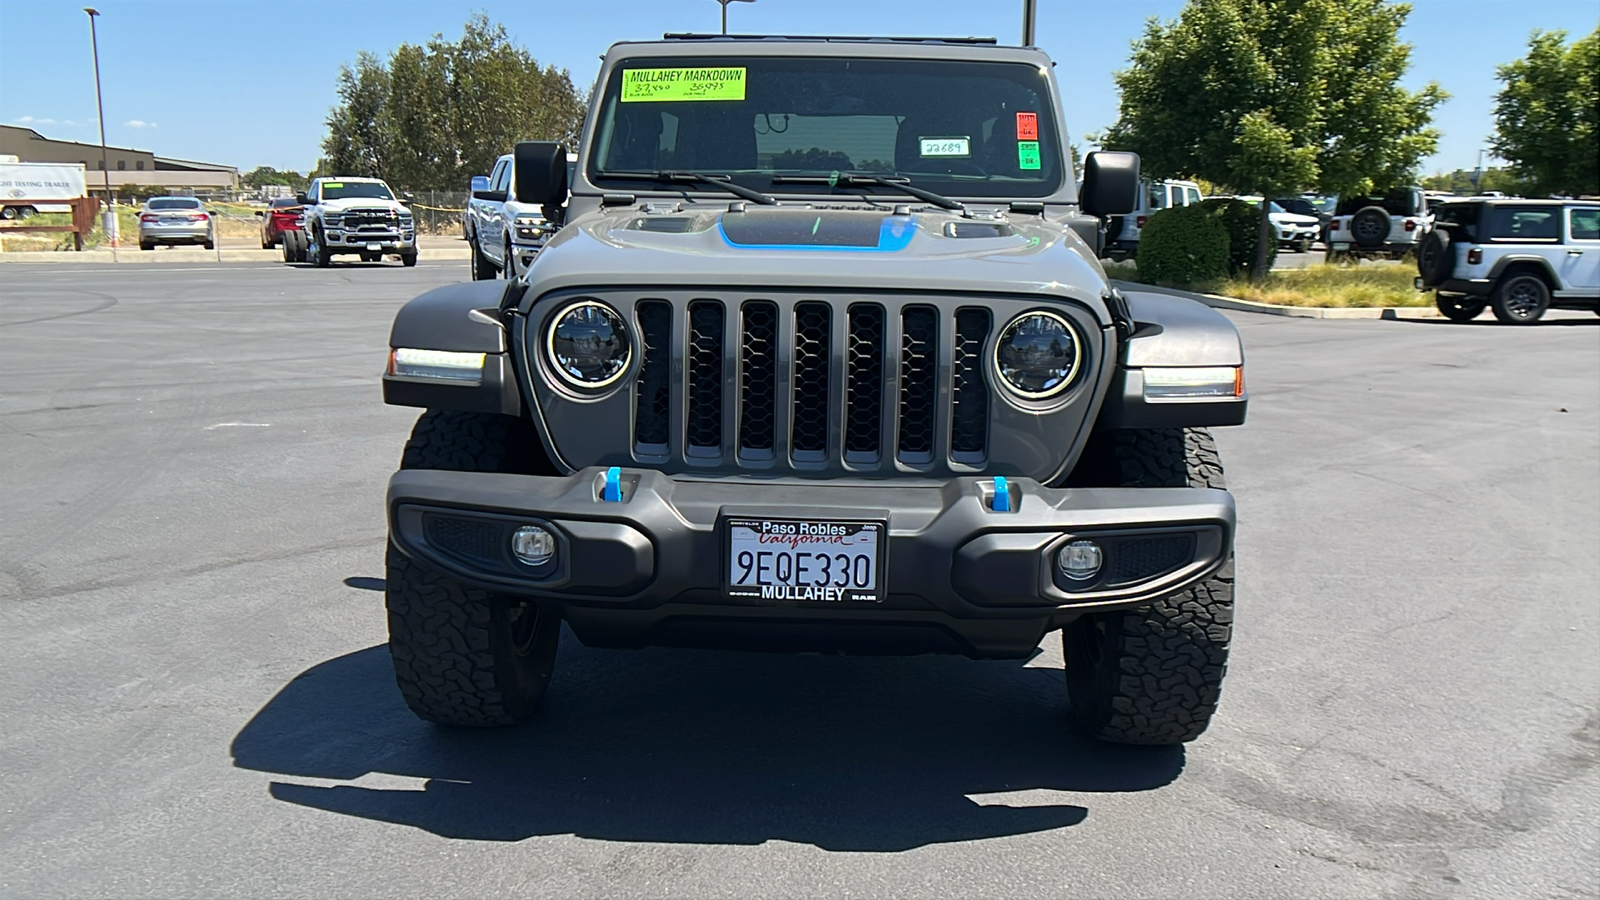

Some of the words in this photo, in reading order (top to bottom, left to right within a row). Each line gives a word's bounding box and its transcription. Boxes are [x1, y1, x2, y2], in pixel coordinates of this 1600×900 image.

[630, 70, 682, 82] MULLAHEY
[684, 69, 742, 81] MARKDOWN
[926, 143, 961, 153] 22689
[762, 521, 796, 534] Paso
[800, 523, 847, 535] Robles
[759, 532, 853, 550] California
[736, 551, 871, 588] 9EQE330
[761, 585, 846, 601] MULLAHEY
